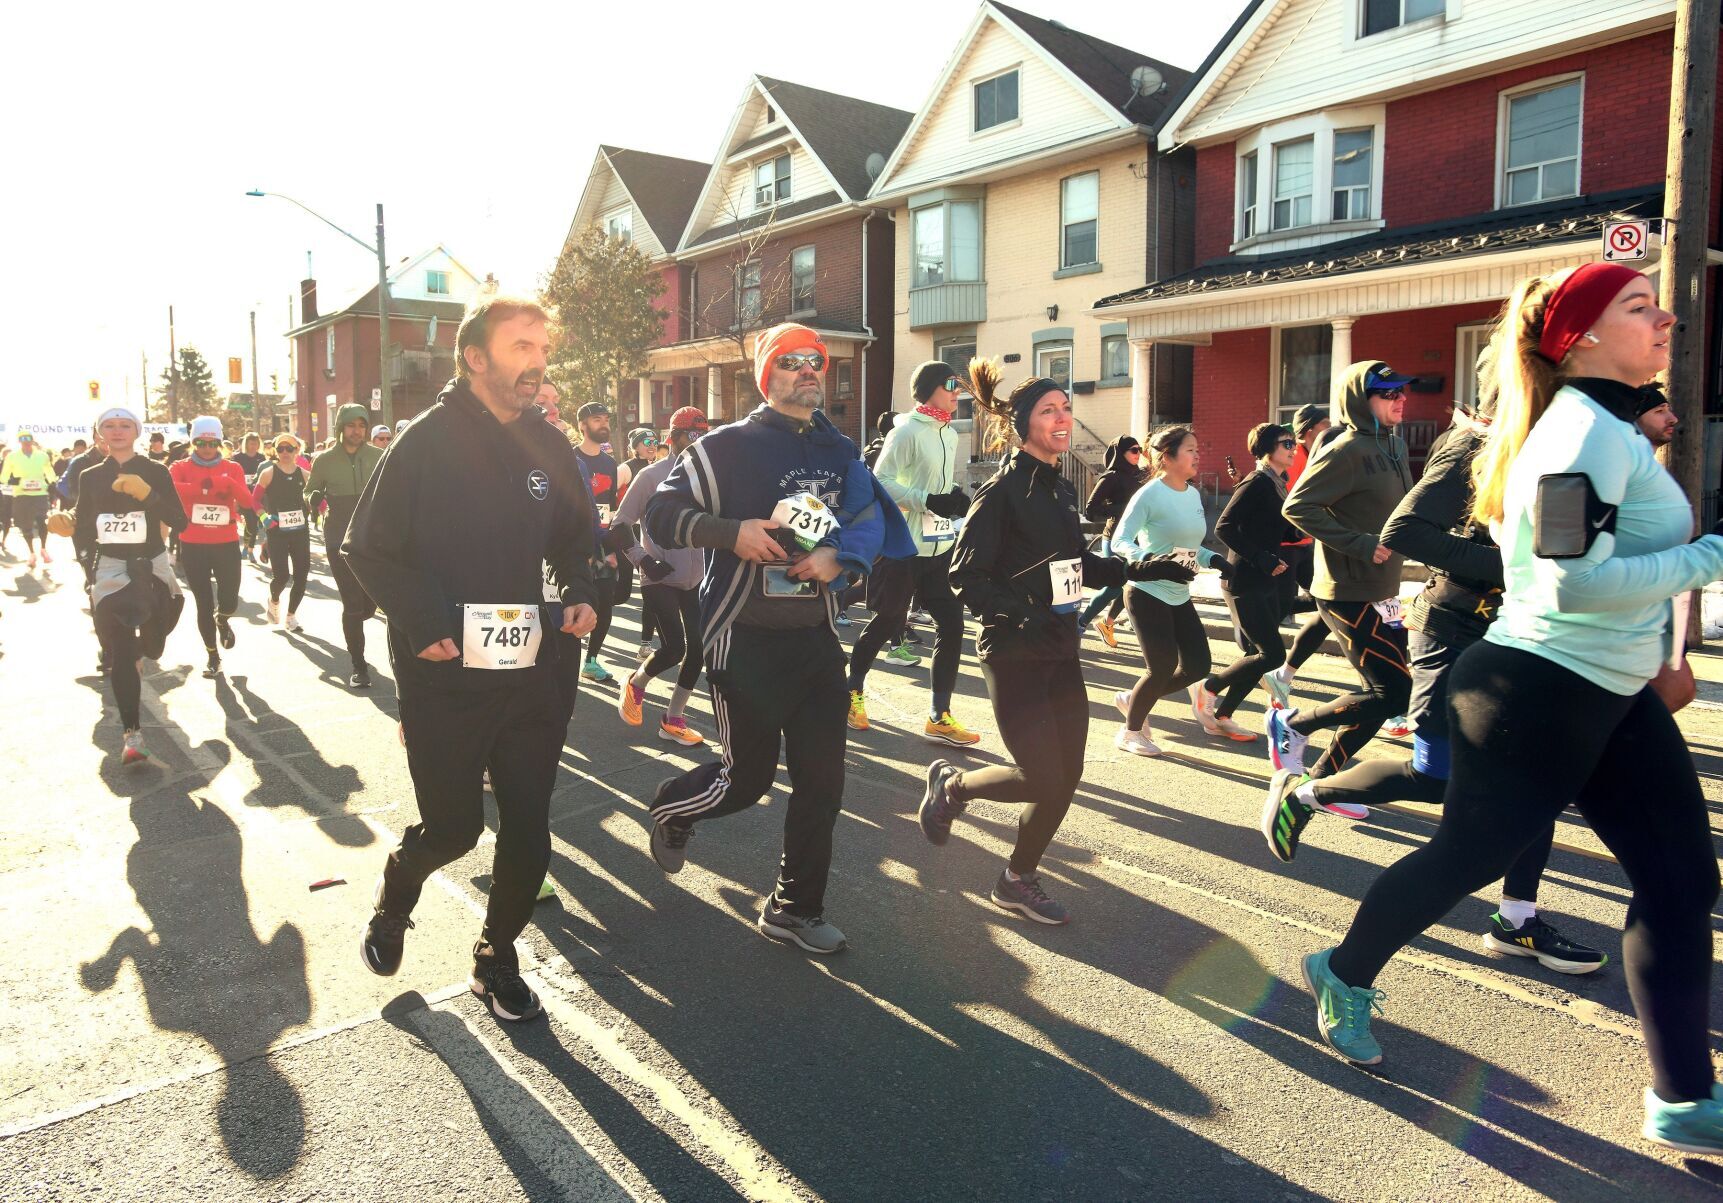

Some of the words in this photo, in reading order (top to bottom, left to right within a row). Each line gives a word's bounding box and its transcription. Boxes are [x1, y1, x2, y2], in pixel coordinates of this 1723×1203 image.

[67, 425, 87, 433] THE
[779, 467, 807, 489] MAPLE
[201, 513, 221, 521] 447
[285, 516, 302, 525] 1494
[788, 506, 832, 537] 7311
[104, 521, 136, 532] 2721
[934, 519, 950, 532] 729
[504, 610, 514, 619] 10K
[524, 611, 536, 620] CN
[480, 626, 531, 648] 7487
